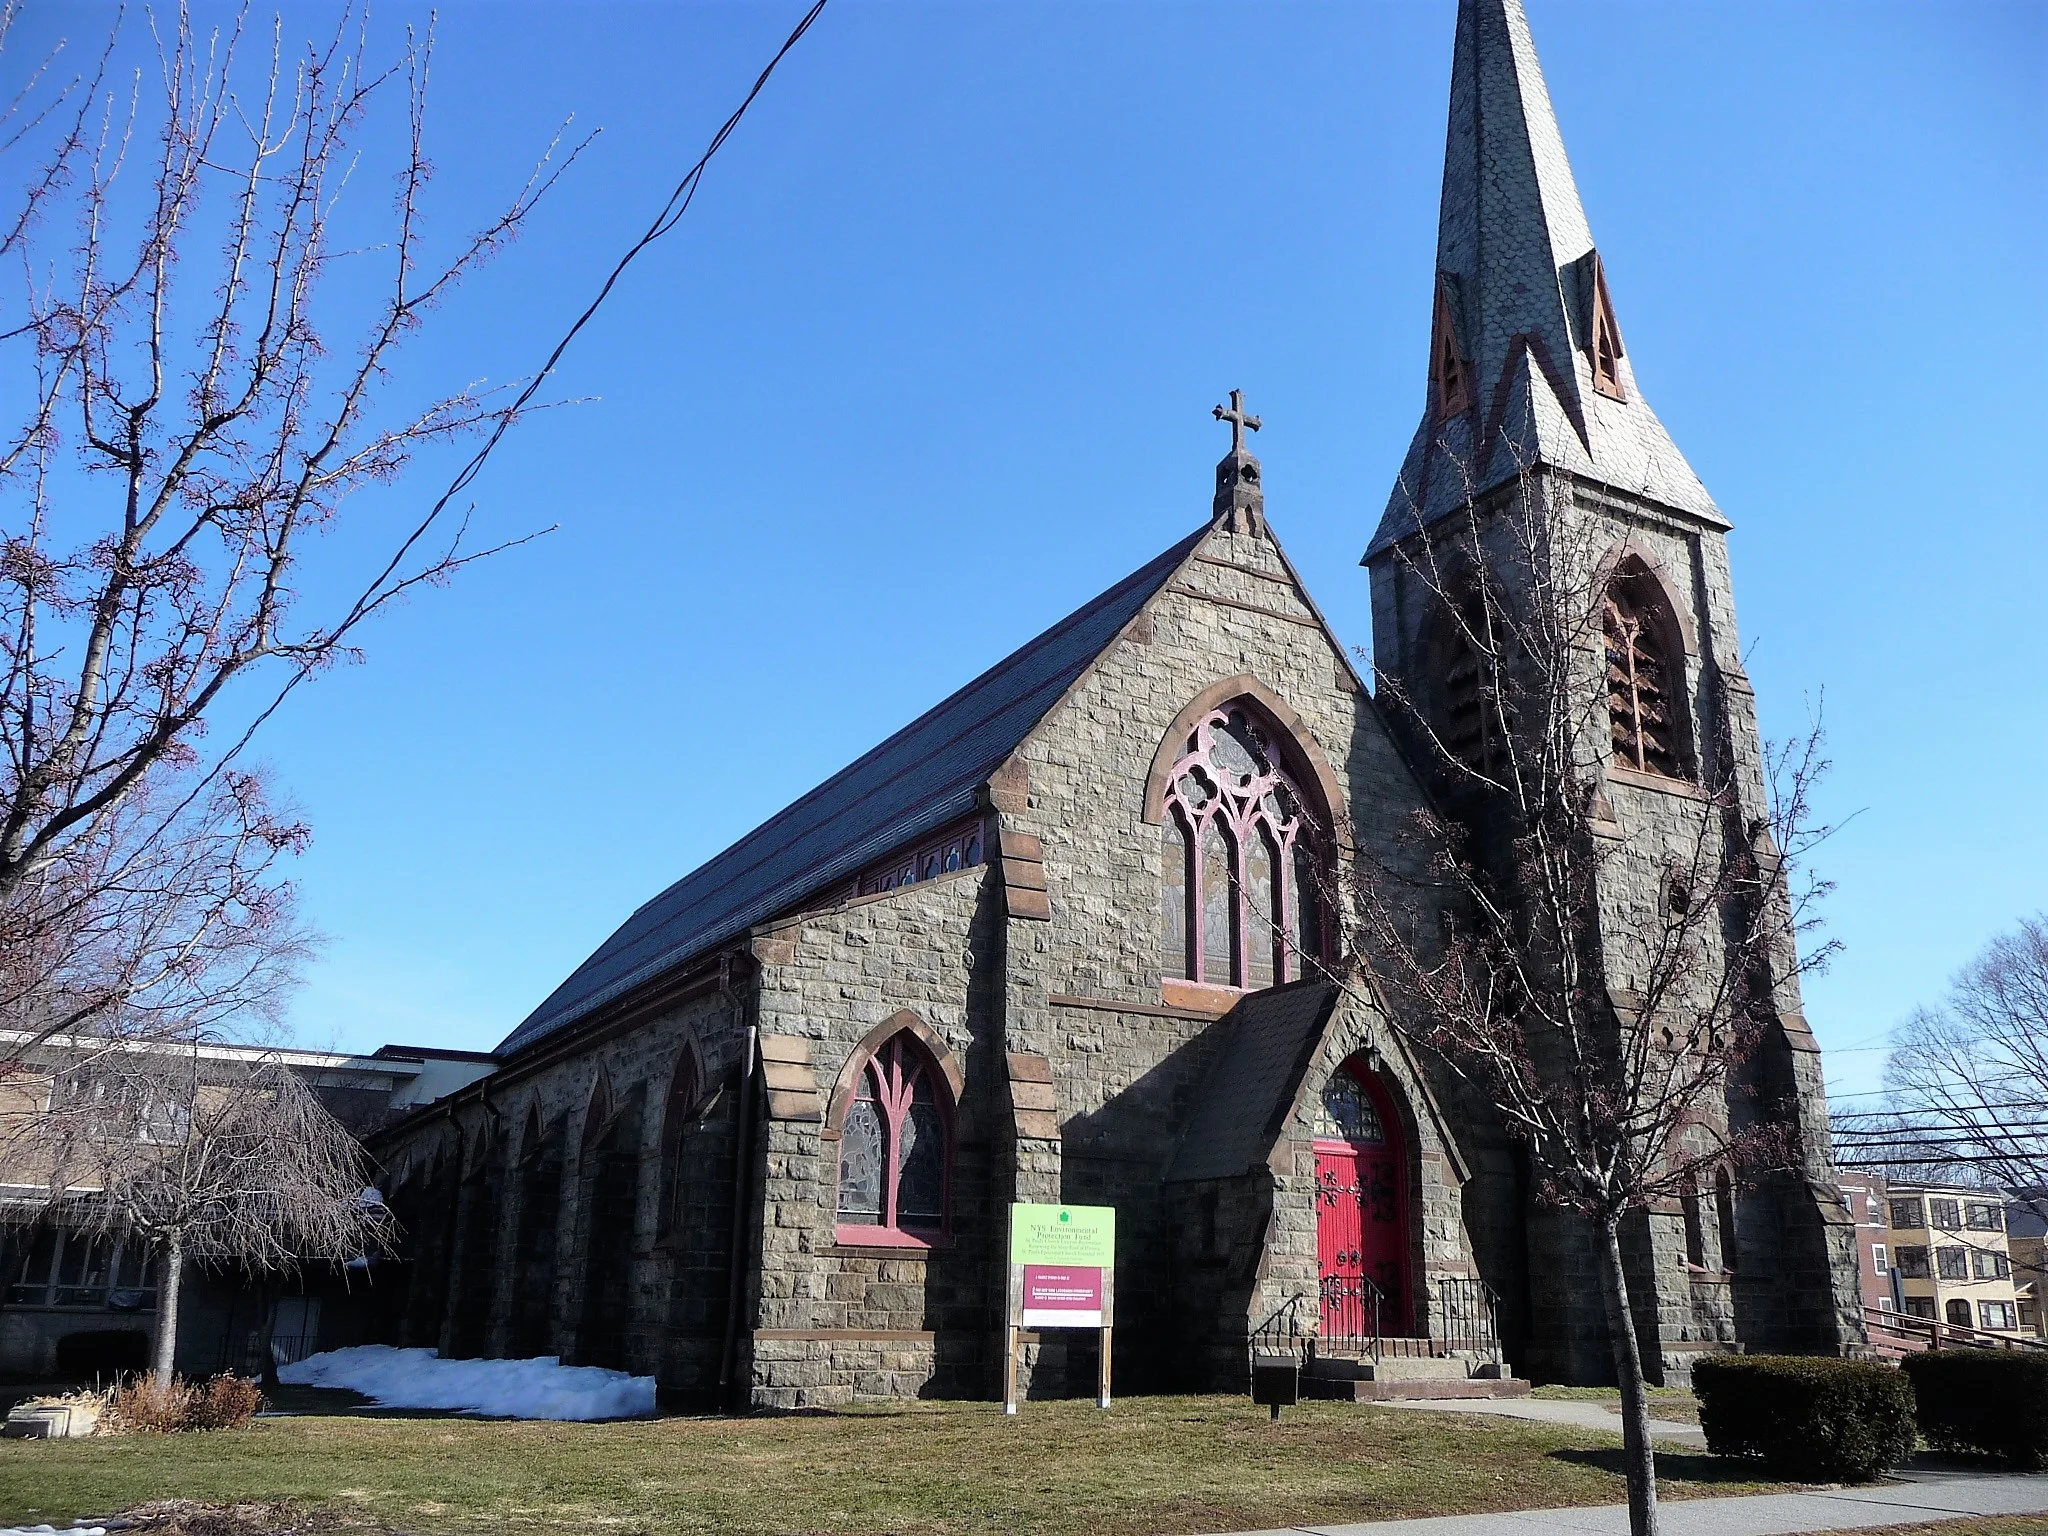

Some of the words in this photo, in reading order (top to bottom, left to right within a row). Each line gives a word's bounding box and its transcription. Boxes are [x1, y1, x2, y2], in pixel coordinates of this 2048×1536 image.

[1030, 1224, 1046, 1232] NYS
[1050, 1225, 1098, 1234] Environmental
[1037, 1231, 1071, 1240] Protection
